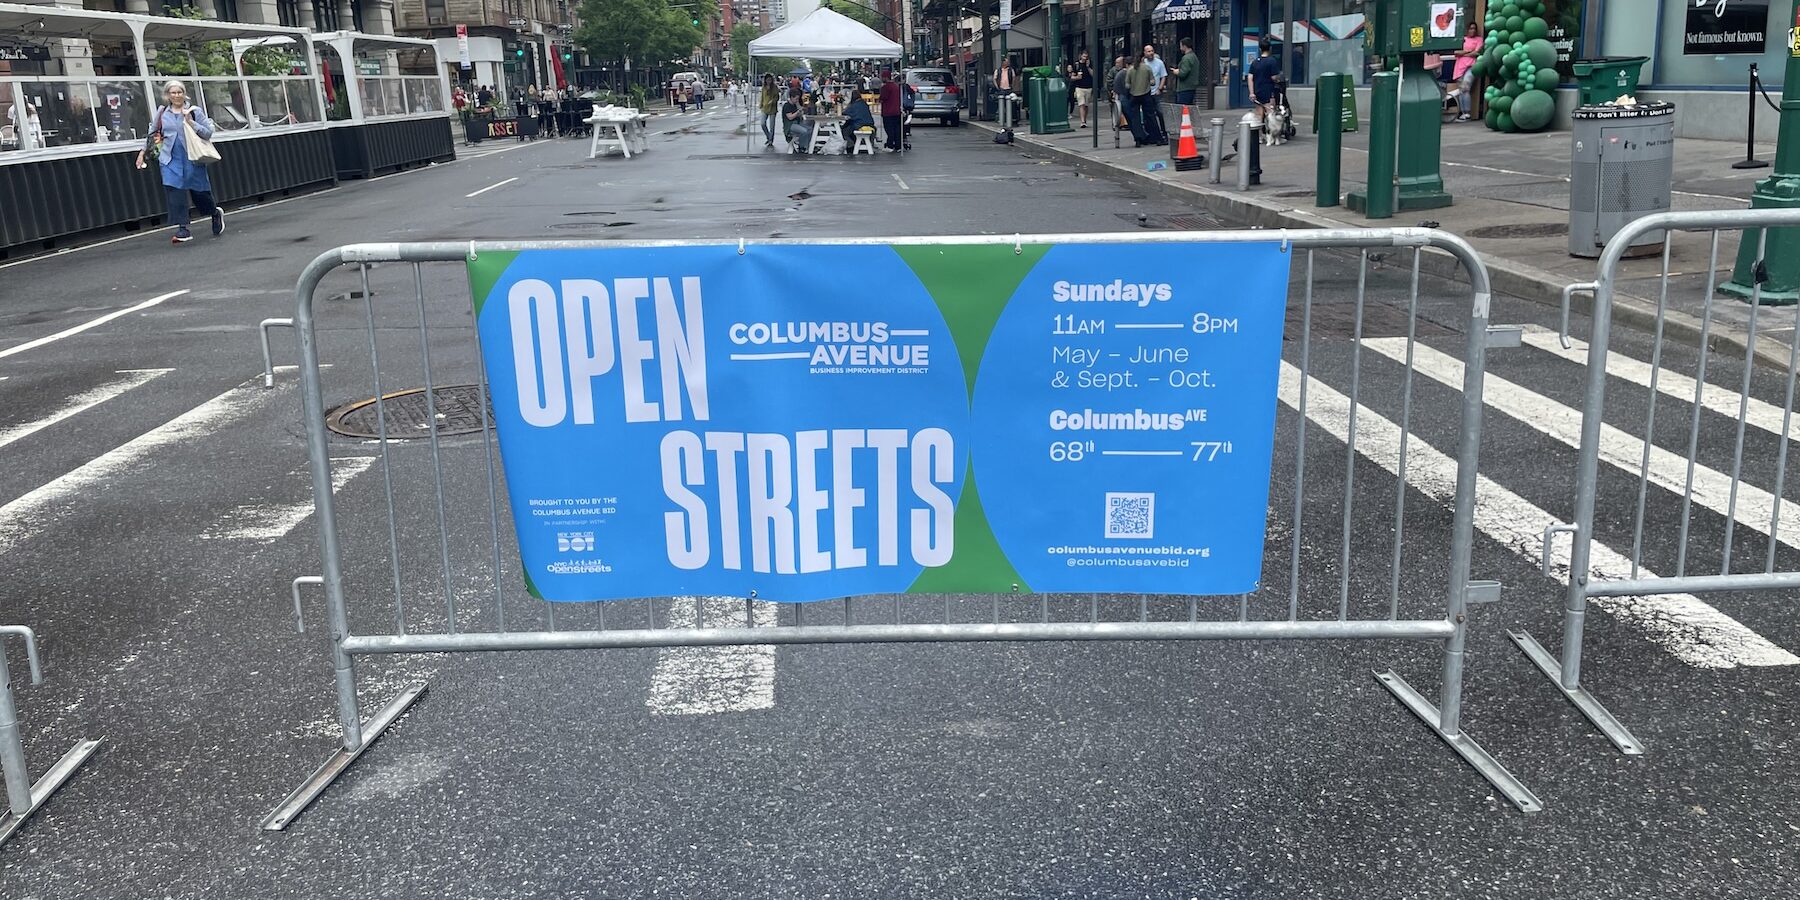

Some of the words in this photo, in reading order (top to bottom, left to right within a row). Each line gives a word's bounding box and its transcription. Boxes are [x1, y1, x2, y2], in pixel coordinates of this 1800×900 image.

[1171, 10, 1211, 20] 580-0066
[1699, 32, 1723, 43] famous
[1723, 31, 1736, 42] but
[1052, 279, 1172, 307] Sundays
[729, 322, 889, 345] COLUMBUS
[1052, 314, 1105, 335] 11AM
[1192, 312, 1238, 334] 8PM
[508, 276, 710, 428] OPEN
[809, 344, 929, 366] AVENUE
[1052, 346, 1101, 368] May
[1129, 345, 1189, 364] June
[1051, 370, 1070, 388] &
[1077, 370, 1139, 392] Sept.
[1168, 369, 1216, 388] Oct.
[1049, 440, 1095, 462] 68th
[1190, 440, 1233, 462] 77th
[532, 508, 571, 516] COLUMBUS
[659, 427, 955, 575] STREETS
[558, 537, 595, 552] DOT
[1047, 545, 1210, 558] columbusavenuebid.org
[546, 563, 612, 574] OpenStreets
[1066, 557, 1190, 568] @columbusavebid
